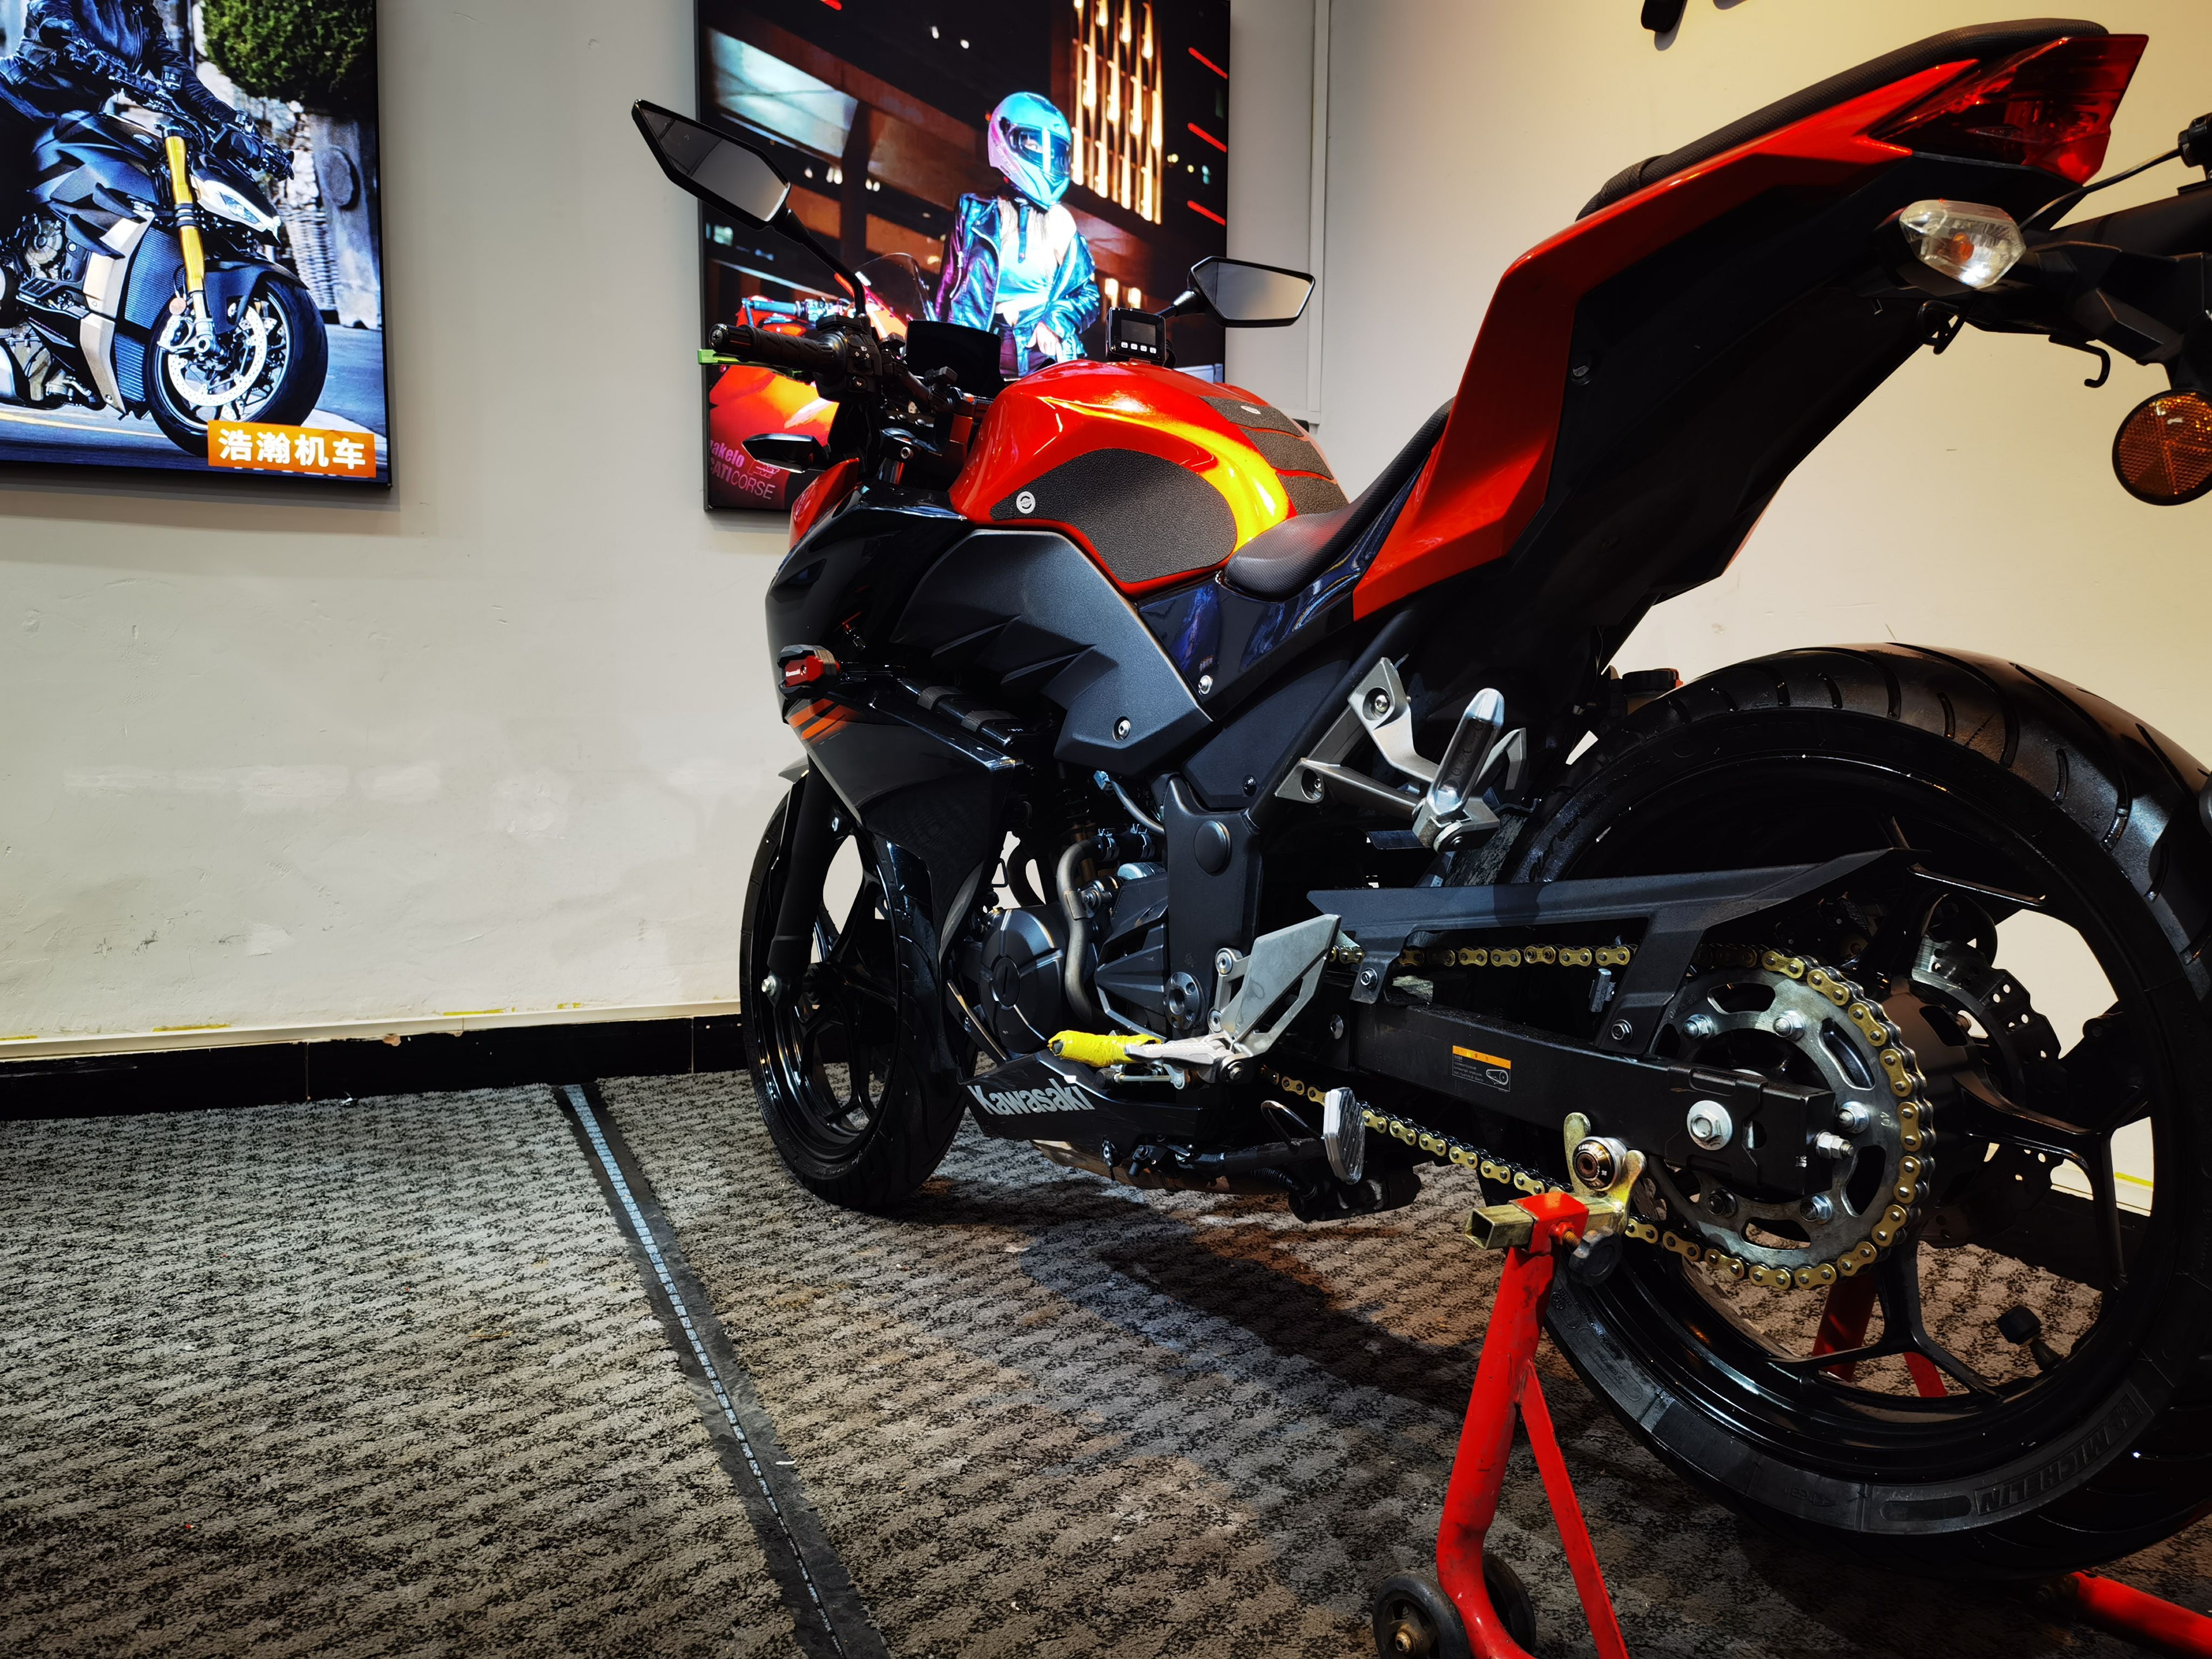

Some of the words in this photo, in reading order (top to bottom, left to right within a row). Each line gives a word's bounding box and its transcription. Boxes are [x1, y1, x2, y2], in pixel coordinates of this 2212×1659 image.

[218, 428, 366, 470] 浩瀚机车
[967, 1078, 1095, 1115] Kawasaki
[1980, 1422, 2110, 1512] MICHELIN
